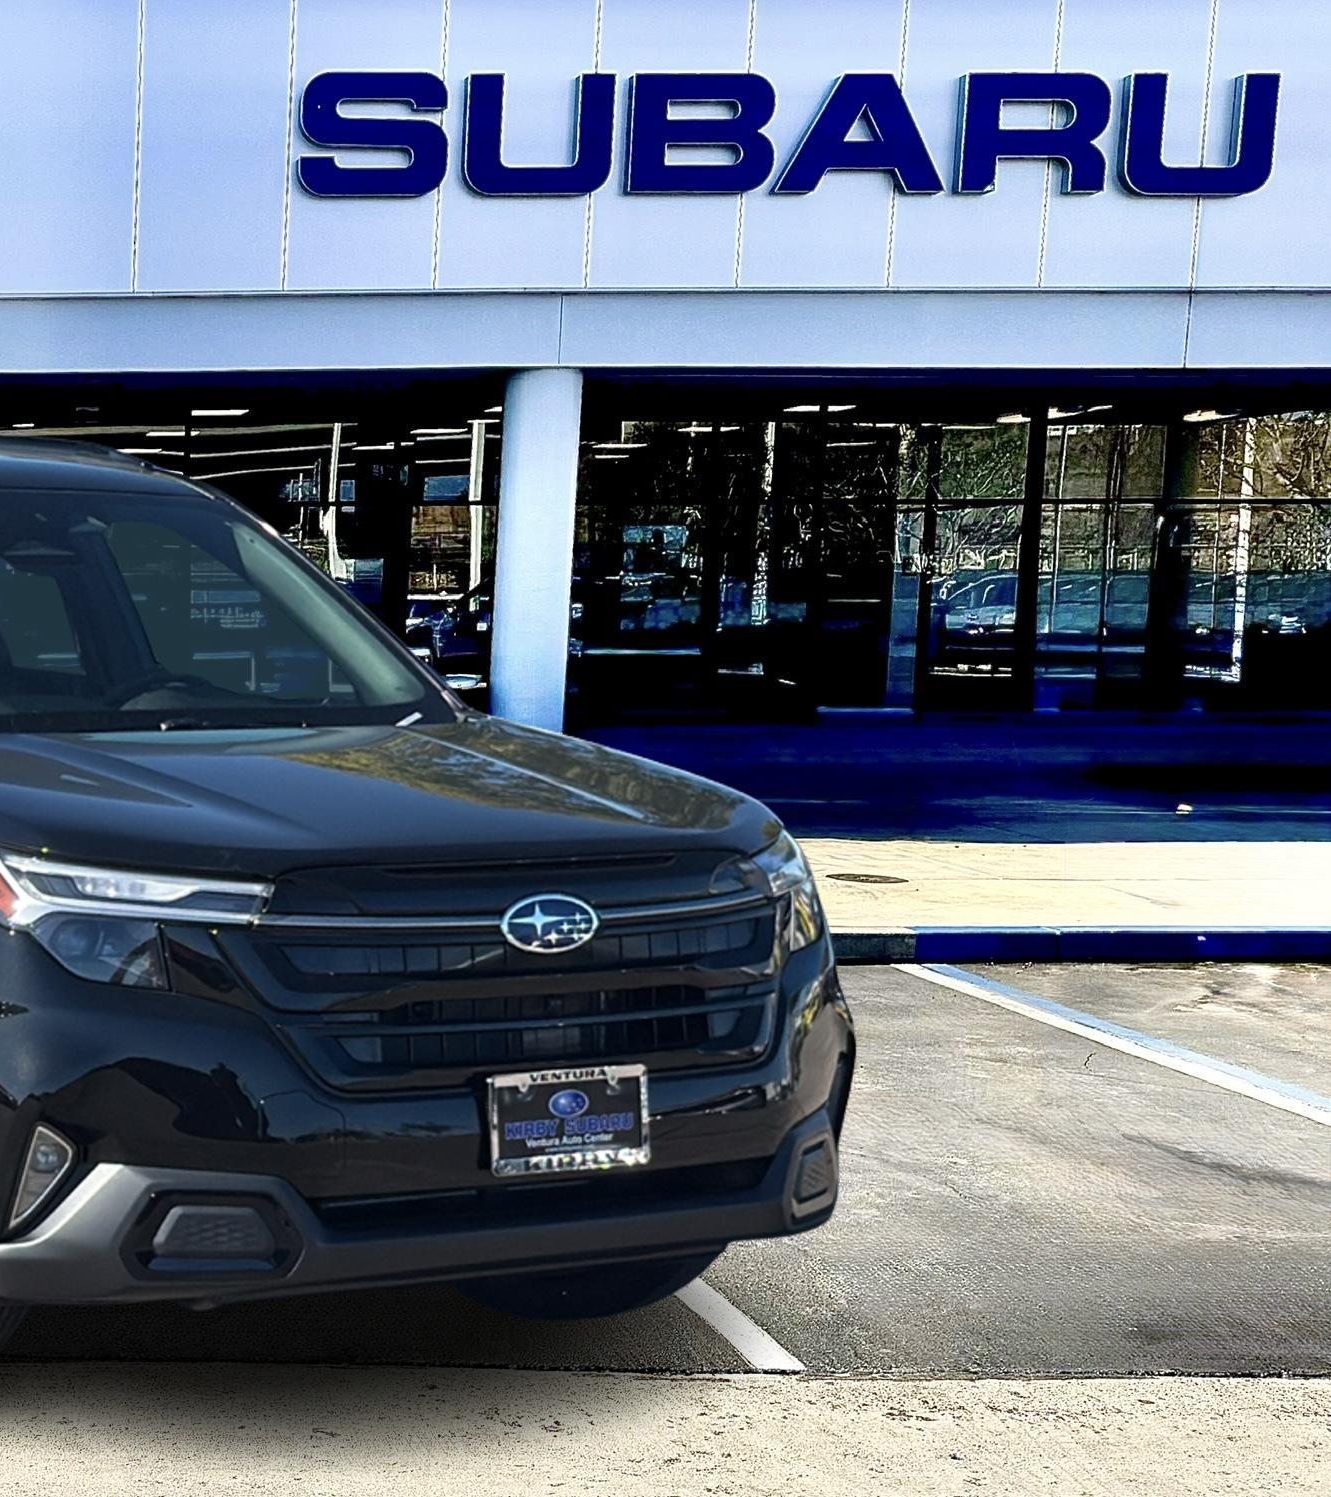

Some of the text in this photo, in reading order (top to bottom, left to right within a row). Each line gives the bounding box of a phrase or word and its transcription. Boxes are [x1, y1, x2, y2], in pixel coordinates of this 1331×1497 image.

[296, 70, 1282, 197] SUBARU
[530, 1069, 607, 1082] VENTURA
[505, 1113, 634, 1140] KIRBY SUBARU
[525, 1136, 560, 1149] Ventura
[561, 1135, 583, 1145] Auto
[584, 1133, 614, 1143] Center
